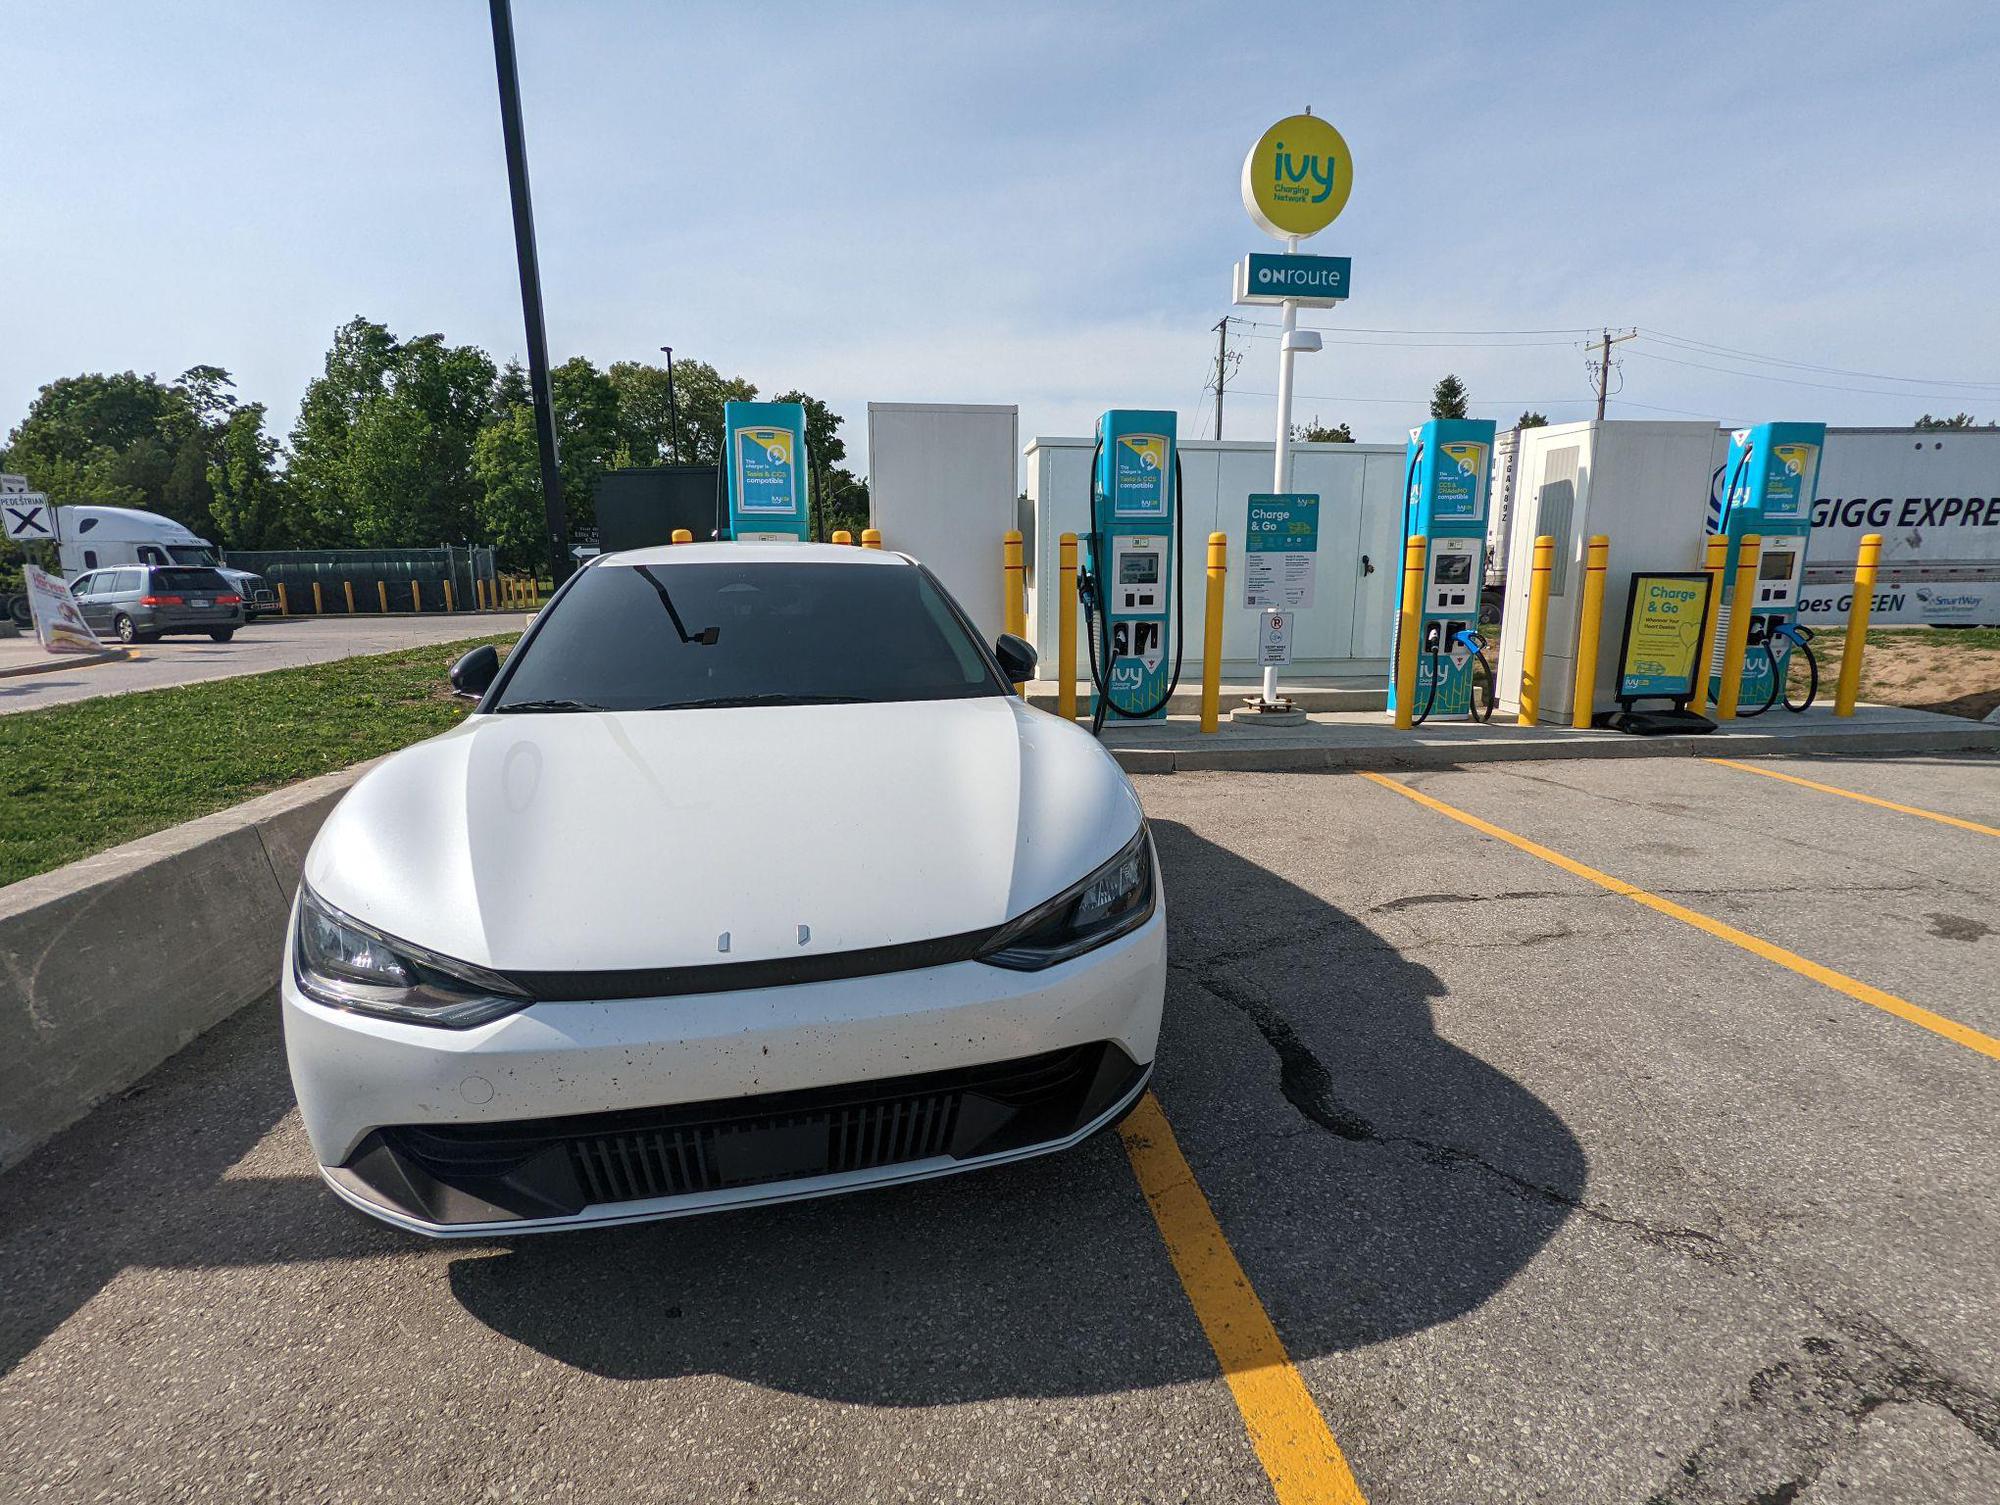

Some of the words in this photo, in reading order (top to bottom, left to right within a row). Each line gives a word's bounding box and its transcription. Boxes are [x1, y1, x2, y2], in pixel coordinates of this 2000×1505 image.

[1274, 141, 1335, 204] ivy
[1273, 184, 1310, 197] Charging
[1273, 193, 1307, 203] Network
[1258, 267, 1340, 287] ONroute
[0, 497, 44, 506] PEDESTRIAN
[1251, 508, 1290, 521] Charge
[1810, 498, 1893, 528] GIGG
[1897, 497, 2000, 527] EXPRE
[1251, 521, 1260, 531] &
[1262, 521, 1277, 531] Go
[1650, 585, 1696, 601] Charge
[1797, 598, 1832, 612] oes
[1837, 594, 1905, 612] GEEN
[1936, 595, 1983, 606] SmartWay
[1647, 601, 1657, 613] &
[1661, 601, 1679, 614] Go
[1111, 663, 1143, 690] ivy
[1625, 676, 1639, 688] ivy
